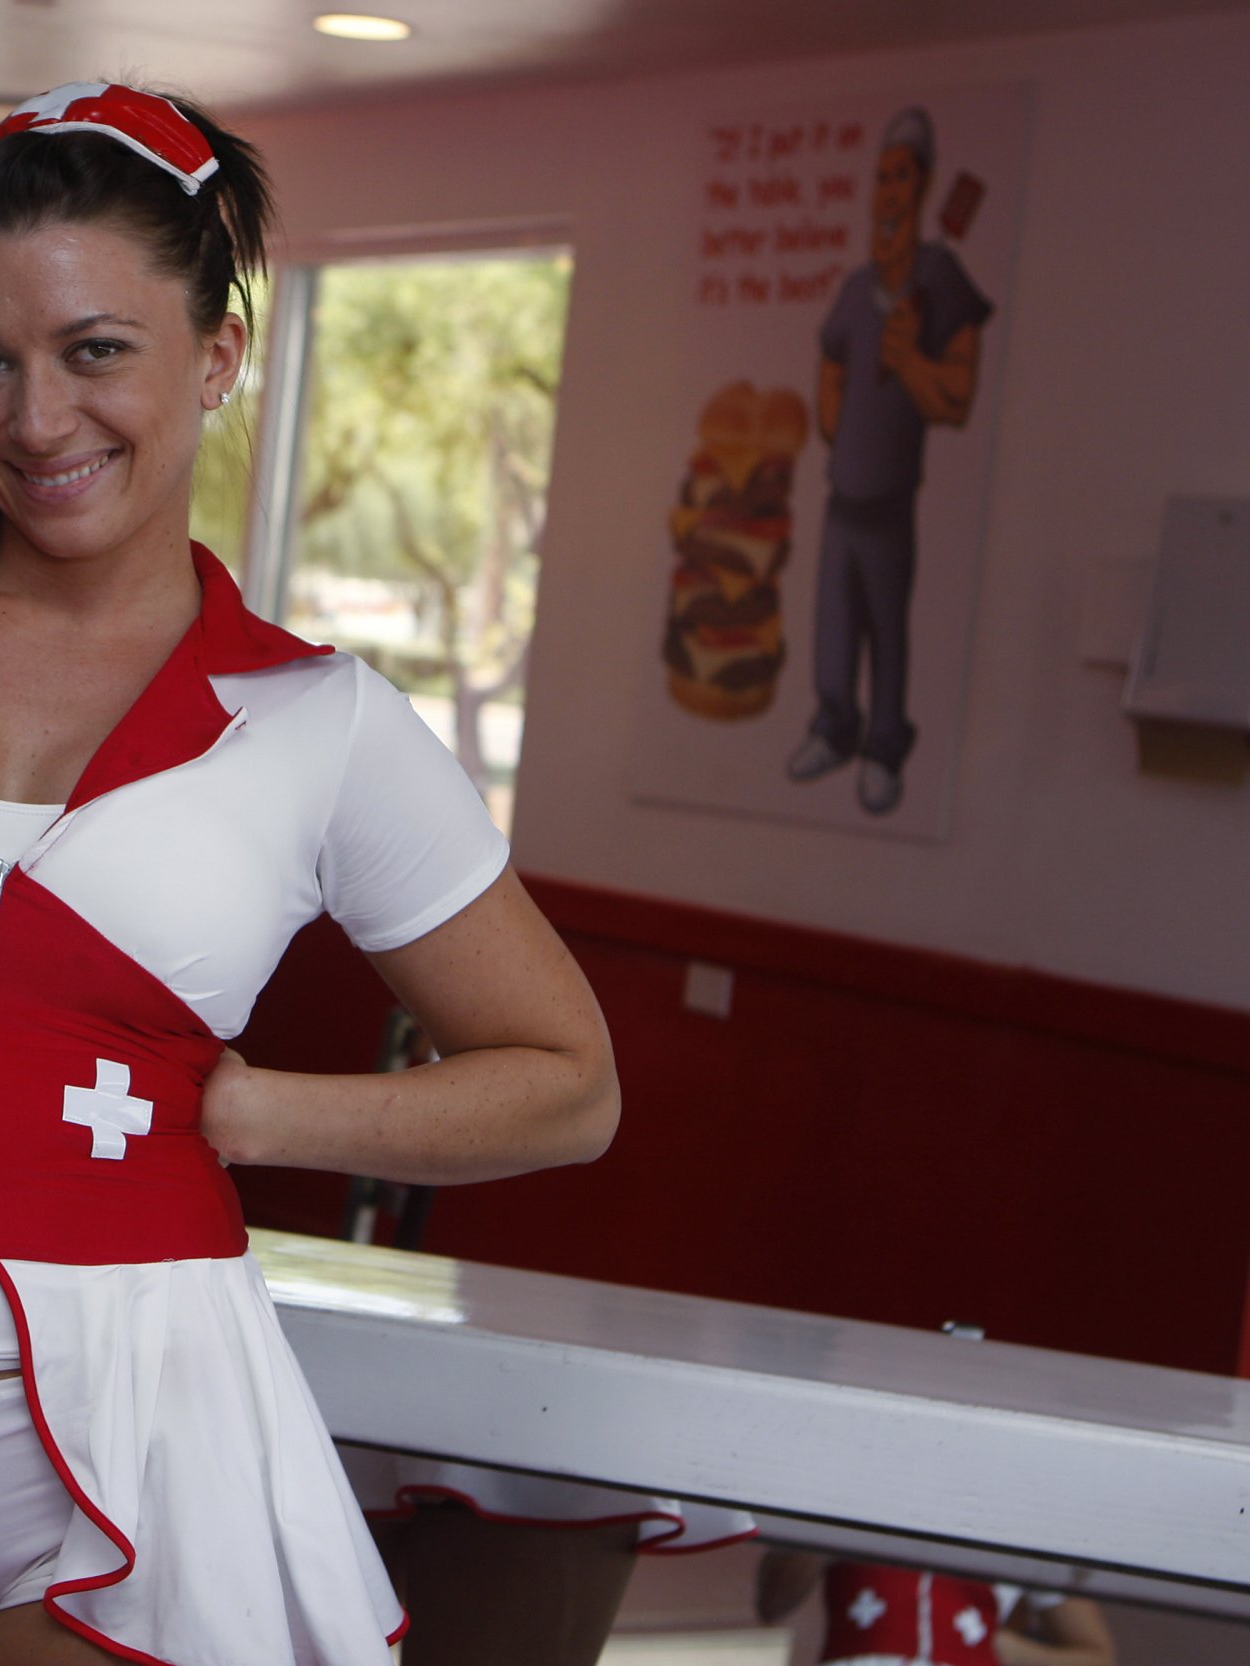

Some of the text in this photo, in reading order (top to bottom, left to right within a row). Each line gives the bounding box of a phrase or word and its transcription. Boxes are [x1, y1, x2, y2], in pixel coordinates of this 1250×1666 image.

[769, 123, 805, 161] put
[812, 119, 832, 151] it
[705, 178, 740, 210] the
[816, 174, 858, 212] you
[699, 219, 850, 260] better believe
[737, 271, 771, 305] the
